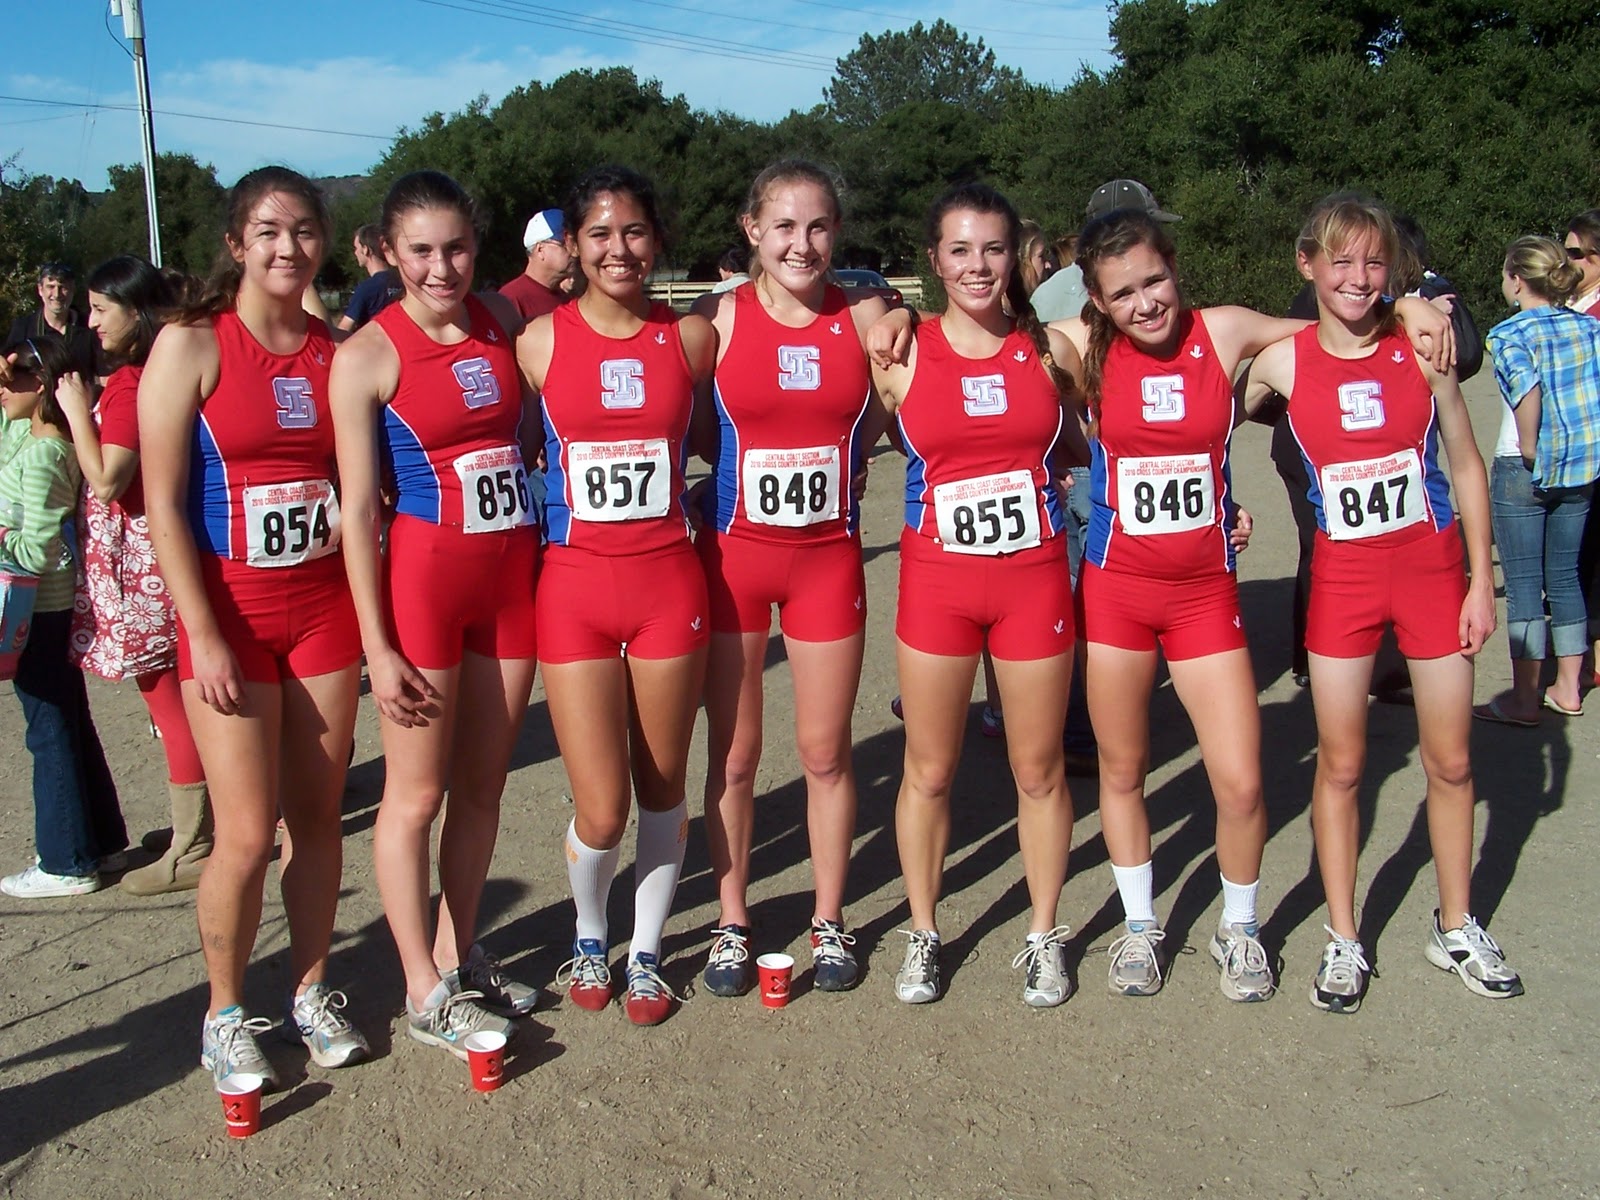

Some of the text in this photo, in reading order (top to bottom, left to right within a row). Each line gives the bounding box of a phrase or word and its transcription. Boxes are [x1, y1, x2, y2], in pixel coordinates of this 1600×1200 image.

[589, 452, 603, 460] CROSS
[604, 451, 625, 459] COUNTRY
[591, 443, 645, 453] CENTRAL COAST SECTION
[765, 451, 820, 461] CENTRAL COAST SECTION
[762, 460, 777, 468] CROSS
[777, 460, 798, 468] COUNTRY
[1137, 468, 1151, 476] CROSS
[1152, 467, 1173, 476] COUNTRY
[1139, 461, 1160, 469] CENTRAL
[1176, 459, 1195, 467] SECTION
[1342, 458, 1398, 474] CENTRAL COAST SECTION
[1340, 473, 1355, 481] CROSS
[1355, 470, 1377, 480] COUNTRY
[585, 461, 656, 510] 857
[759, 470, 827, 515] 848
[955, 476, 1011, 493] CENTRAL COAST SECTION
[477, 468, 529, 521] 856
[954, 491, 968, 501] CROSS
[969, 488, 990, 498] COUNTRY
[1134, 477, 1203, 524] 846
[1339, 474, 1409, 528] 847
[953, 495, 1026, 545] 855
[263, 504, 331, 556] 854
